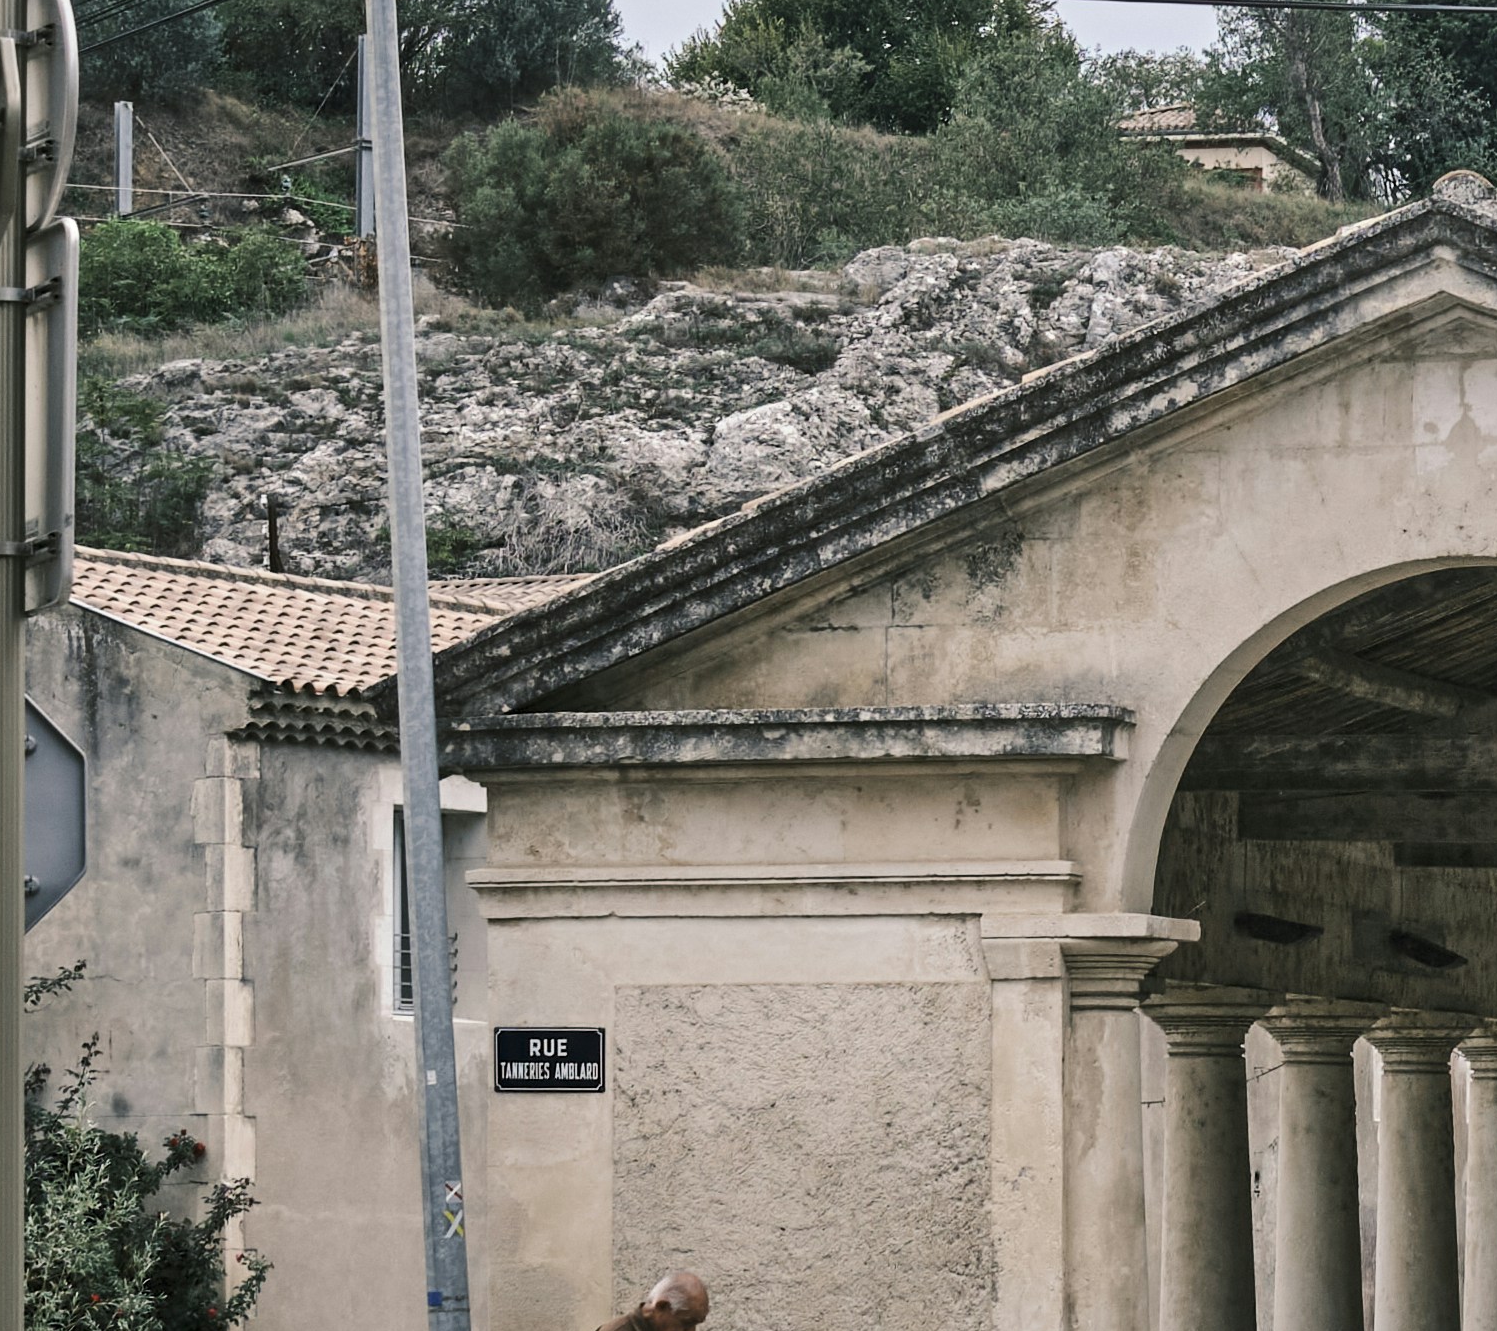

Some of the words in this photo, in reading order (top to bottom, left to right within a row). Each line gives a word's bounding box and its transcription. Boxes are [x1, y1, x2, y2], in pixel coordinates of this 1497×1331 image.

[529, 1038, 568, 1057] RUE
[500, 1061, 550, 1080] TANNERIES
[554, 1061, 599, 1080] AMBLARD
